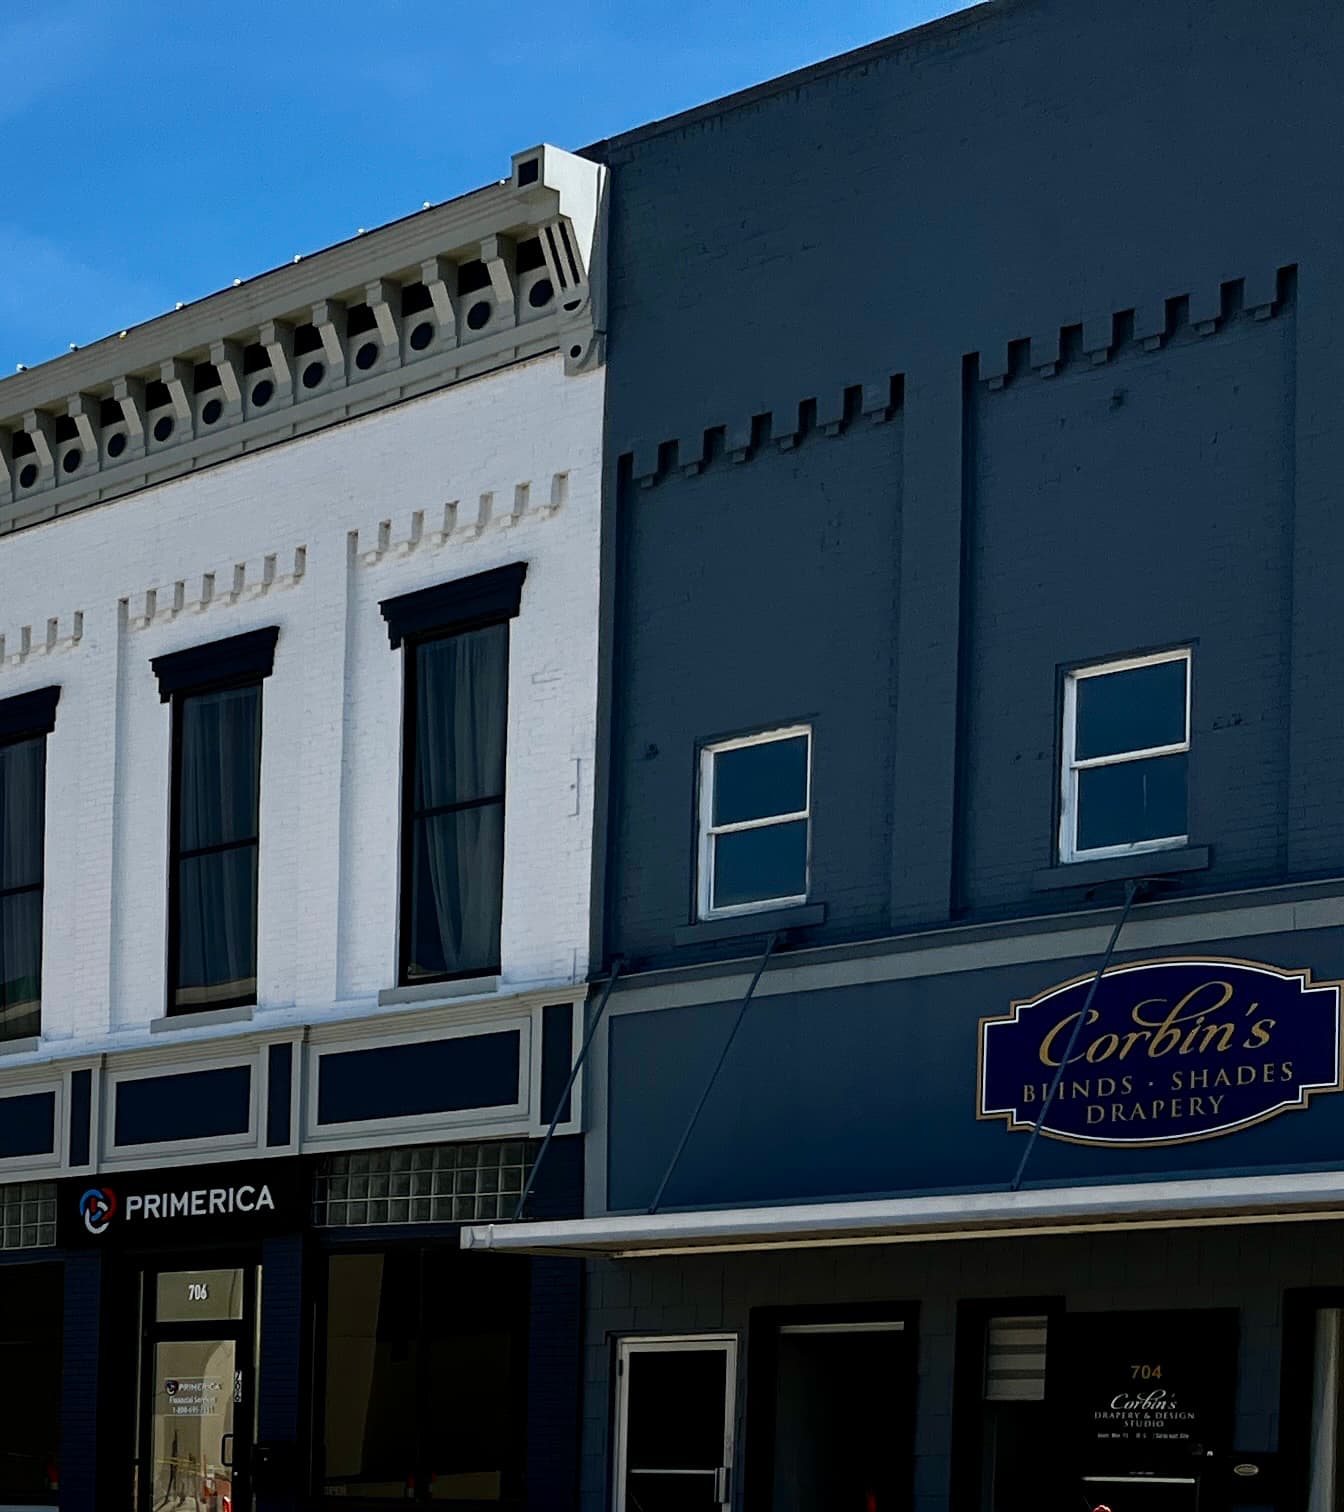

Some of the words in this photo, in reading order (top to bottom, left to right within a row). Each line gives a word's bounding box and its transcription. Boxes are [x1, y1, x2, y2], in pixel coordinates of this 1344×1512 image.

[1039, 981, 1277, 1067] Corbin's
[1023, 1075, 1134, 1103] BLINDS
[1171, 1061, 1294, 1091] SHADES
[1086, 1095, 1225, 1125] DRAPERY
[125, 1185, 275, 1221] PRIMERICA
[188, 1284, 207, 1300] 706
[1130, 1364, 1163, 1380] 704
[1110, 1389, 1178, 1410] Corbin's
[1094, 1411, 1141, 1420] DRAPERY
[1144, 1412, 1151, 1420] &
[1155, 1411, 1196, 1420] DESIGN
[1124, 1420, 1165, 1428] STUDIO
